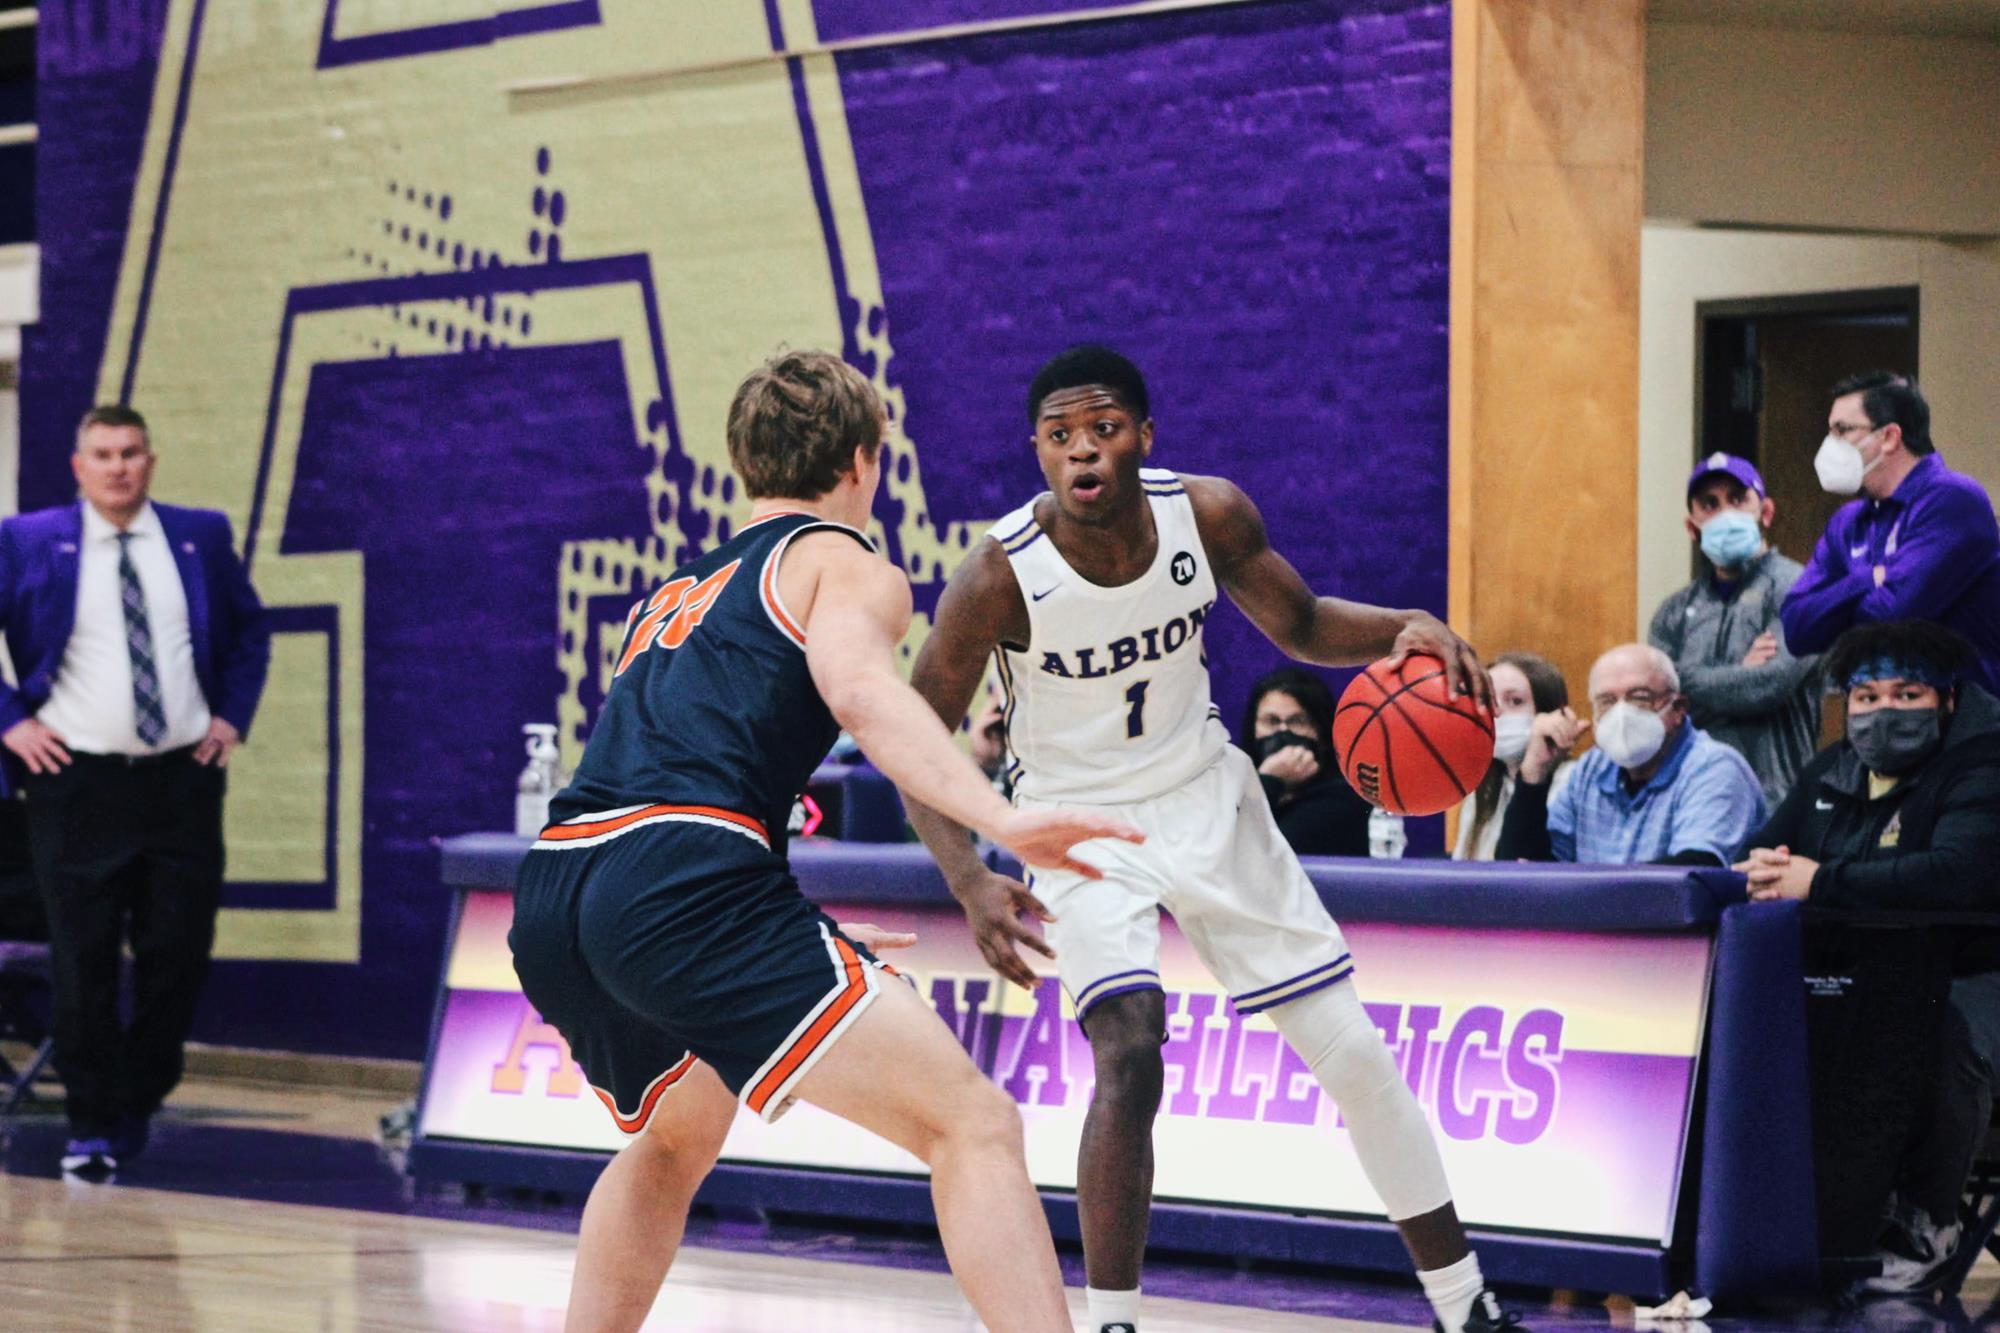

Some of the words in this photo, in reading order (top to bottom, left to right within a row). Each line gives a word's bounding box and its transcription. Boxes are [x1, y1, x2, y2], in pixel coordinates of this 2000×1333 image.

[1040, 601, 1215, 679] ALBION
[1125, 679, 1150, 739] 1
[1003, 977, 1564, 1145] AHLEICS
